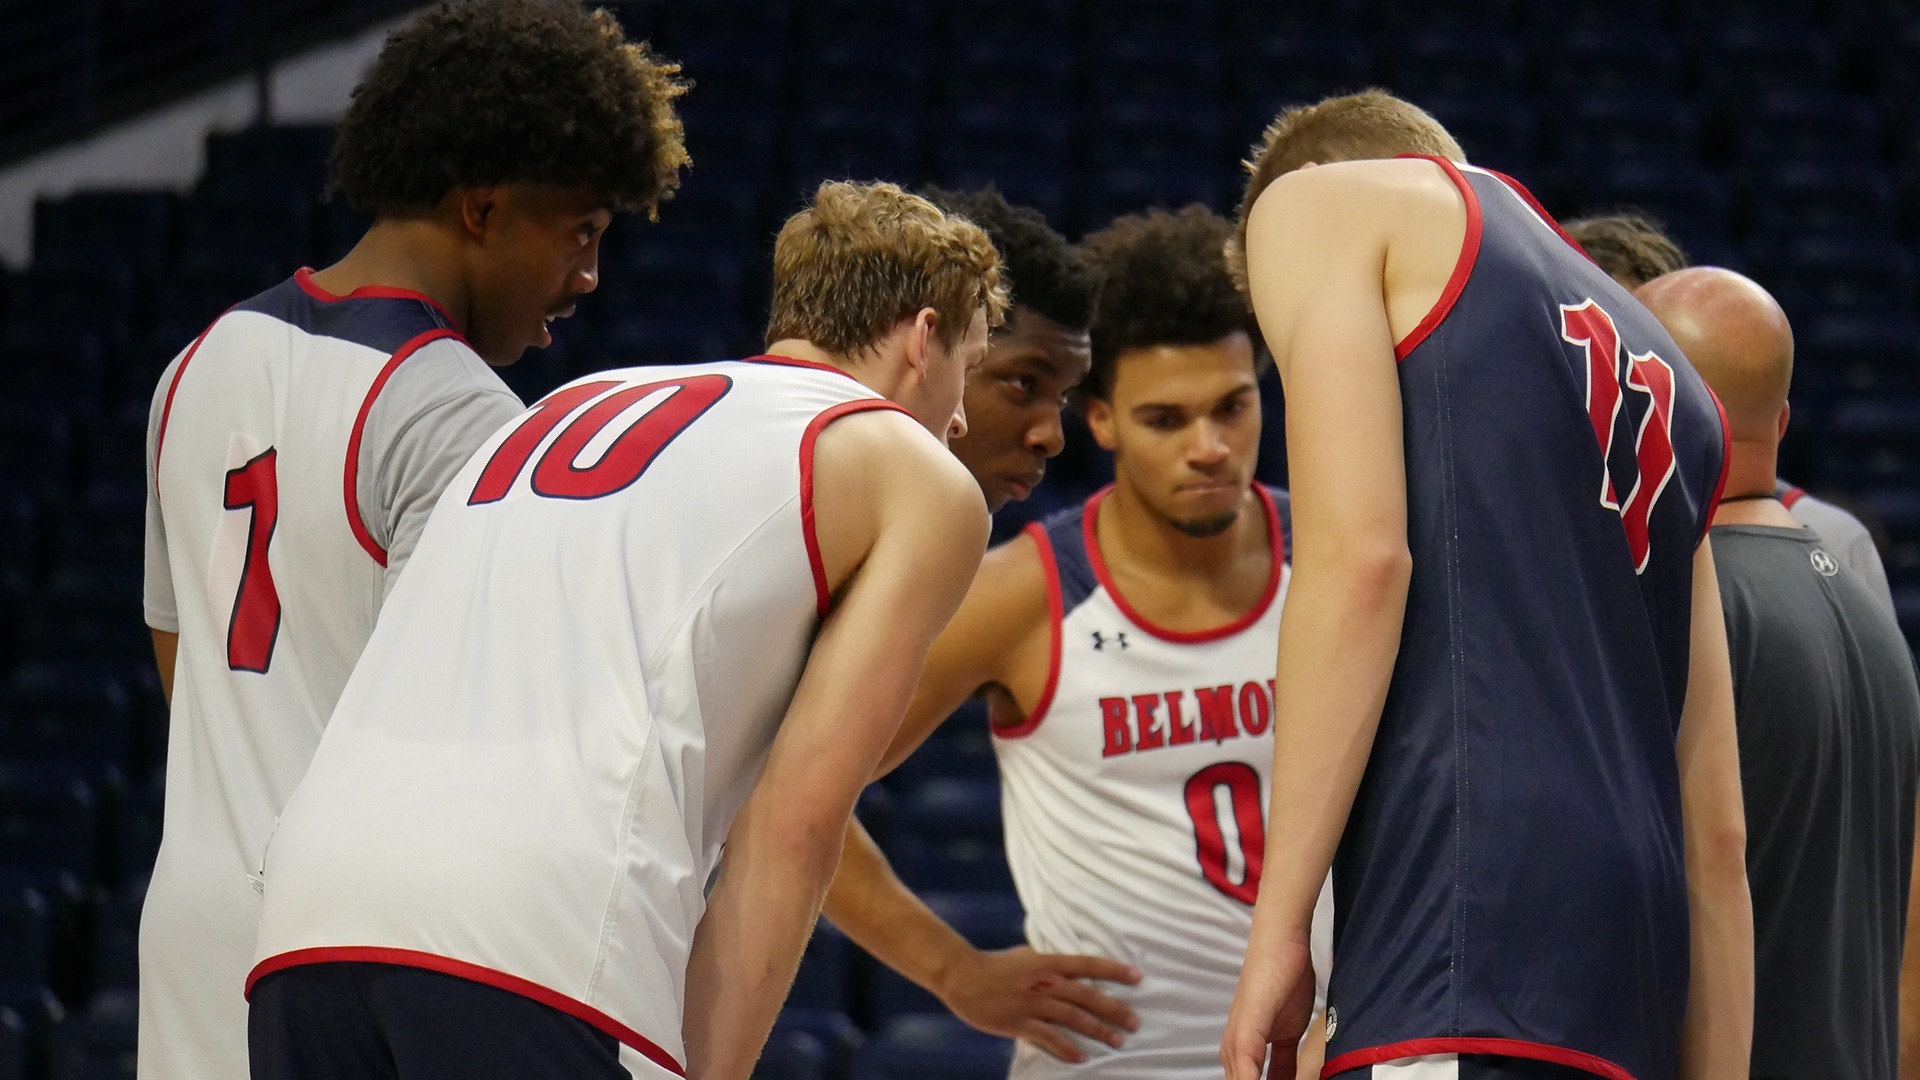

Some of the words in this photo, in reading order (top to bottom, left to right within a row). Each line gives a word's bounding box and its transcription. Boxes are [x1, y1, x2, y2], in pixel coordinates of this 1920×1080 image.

[467, 374, 734, 506] 10
[224, 446, 281, 674] 1
[1099, 679, 1276, 758] BELMO
[1183, 761, 1265, 905] 0
